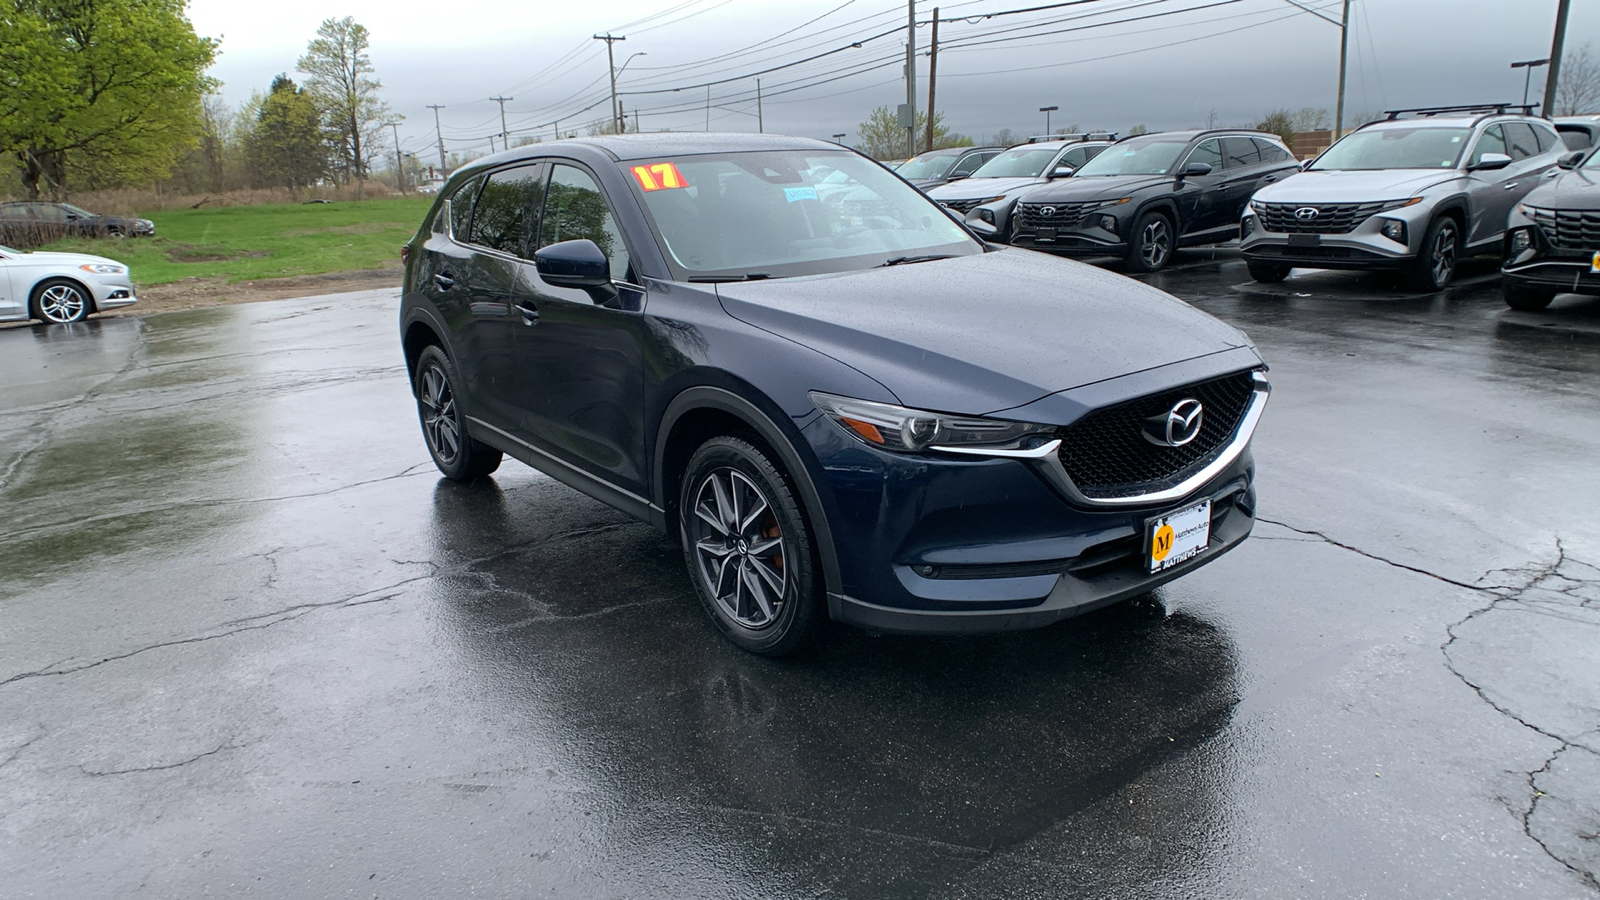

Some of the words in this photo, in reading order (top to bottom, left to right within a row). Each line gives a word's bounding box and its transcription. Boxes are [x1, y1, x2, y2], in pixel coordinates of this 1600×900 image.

[634, 163, 680, 190] 17
[1198, 521, 1209, 530] Auto
[1155, 532, 1171, 555] M
[1163, 550, 1197, 569] MATTHEWS
